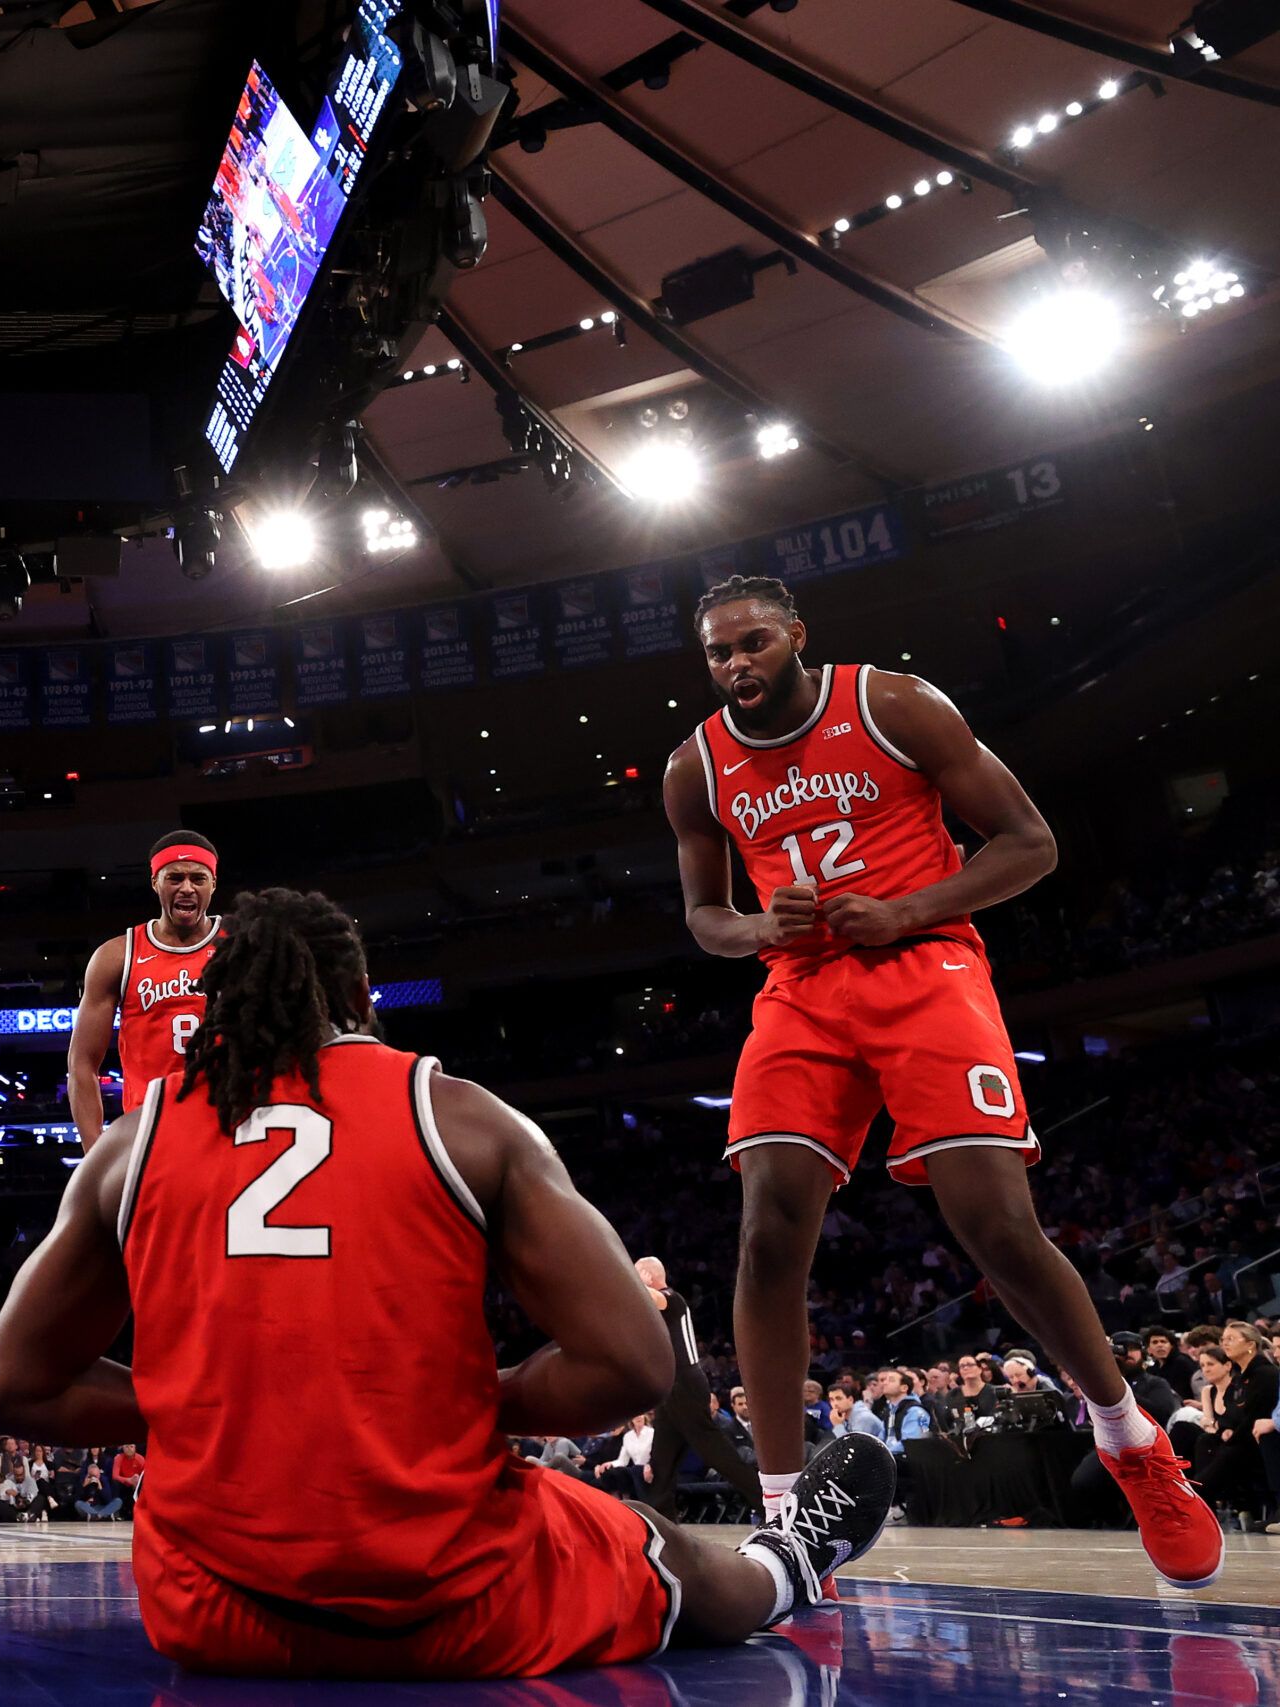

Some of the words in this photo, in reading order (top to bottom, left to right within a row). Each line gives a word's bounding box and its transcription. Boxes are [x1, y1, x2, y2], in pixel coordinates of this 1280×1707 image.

[1007, 461, 1061, 504] 13
[775, 530, 814, 557] BILLY
[819, 511, 894, 566] 104
[784, 551, 817, 575] JOEL
[556, 616, 608, 636] 2014-15
[621, 604, 678, 624] 2023-24
[491, 628, 540, 646] 2014-15
[731, 765, 880, 840] Buckeyes
[781, 820, 866, 888] 12
[173, 1014, 199, 1054] 8
[226, 1103, 333, 1258] 2
